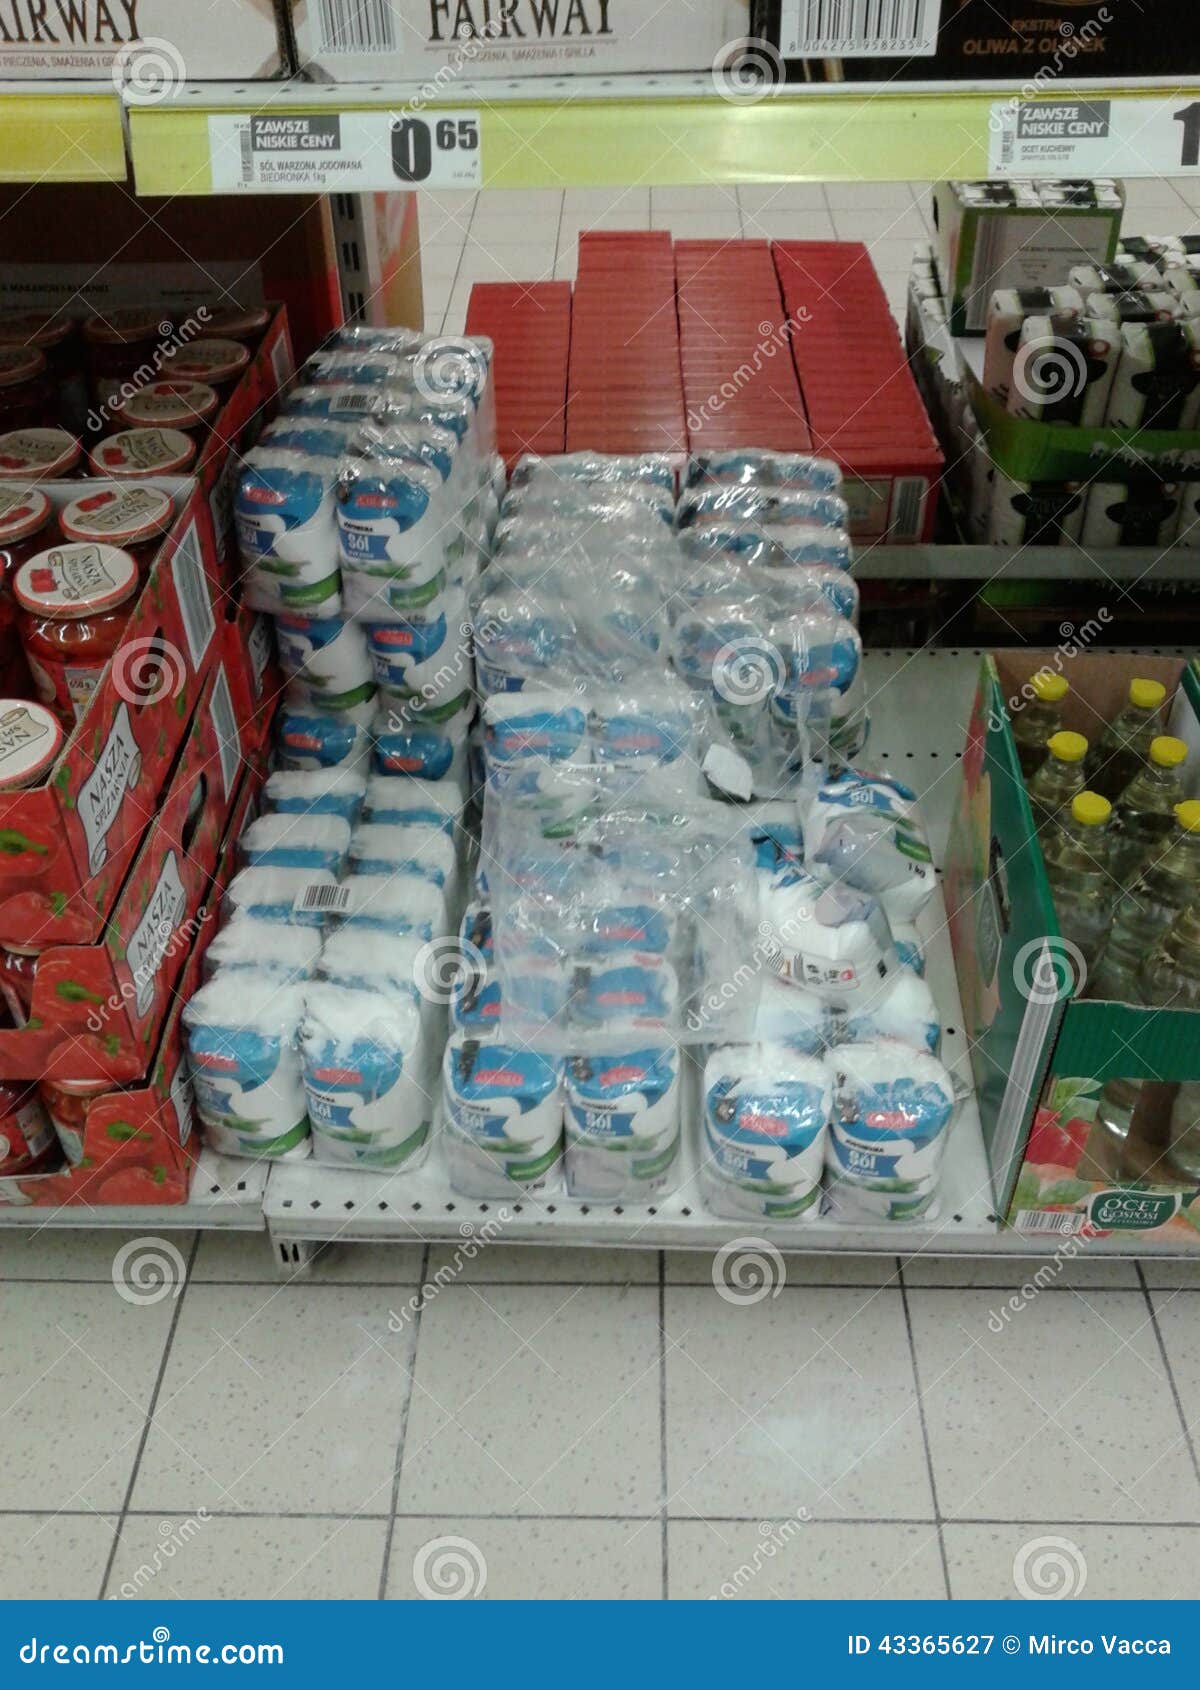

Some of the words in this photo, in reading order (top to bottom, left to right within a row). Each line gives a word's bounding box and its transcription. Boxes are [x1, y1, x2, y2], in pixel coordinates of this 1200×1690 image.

[428, 0, 613, 41] FAIRWAY
[963, 39, 1019, 55] OLIWA
[1023, 107, 1079, 121] ZAWSZE
[255, 120, 310, 134] ZAWSZE
[1021, 122, 1065, 137] NISKIE
[1067, 121, 1105, 135] CENY
[255, 135, 297, 149] NISKIE
[300, 134, 335, 148] CENY
[391, 118, 432, 182] 0
[436, 119, 479, 150] 65
[90, 734, 125, 813] NASZA
[1104, 1198, 1166, 1213] OCET
